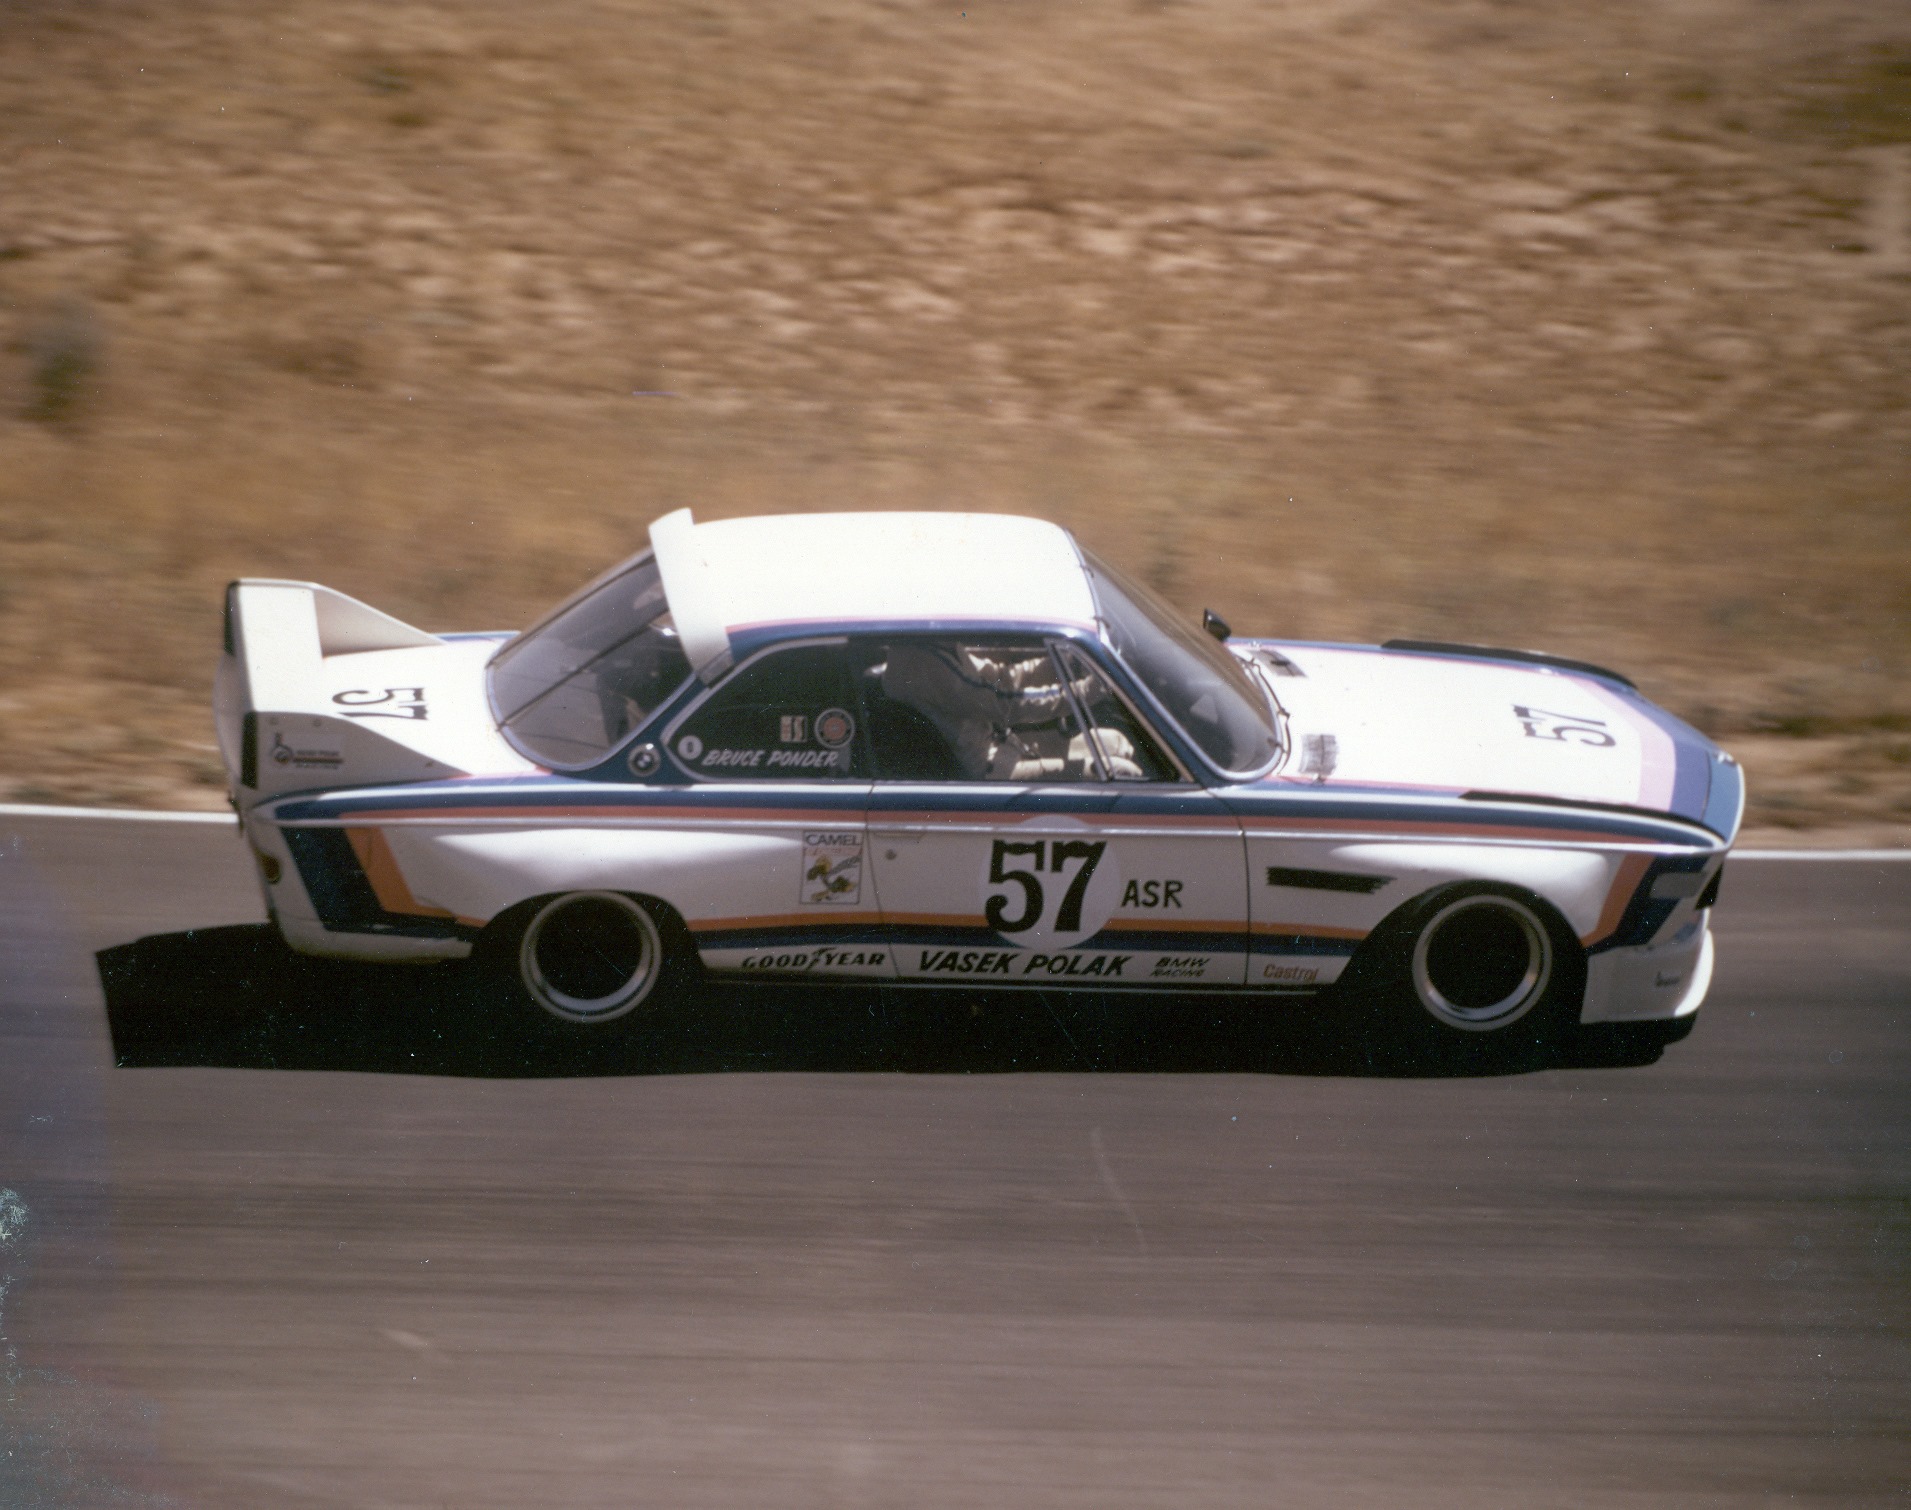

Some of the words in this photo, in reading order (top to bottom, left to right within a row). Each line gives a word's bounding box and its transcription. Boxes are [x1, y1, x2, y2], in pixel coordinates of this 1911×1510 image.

[332, 687, 428, 720] 57
[1511, 704, 1616, 747] 57
[702, 749, 765, 766] BRUCE
[767, 750, 839, 767] PONDER
[805, 834, 863, 846] CAMEL
[985, 839, 1107, 933] 57
[1121, 879, 1183, 908] ASR
[742, 947, 886, 971] GOODYEAR
[918, 950, 1017, 974] VASEK
[1023, 952, 1132, 977] POLAK
[1155, 957, 1210, 968] BMW
[1150, 967, 1205, 978] RACING
[1262, 963, 1320, 983] Castrol
